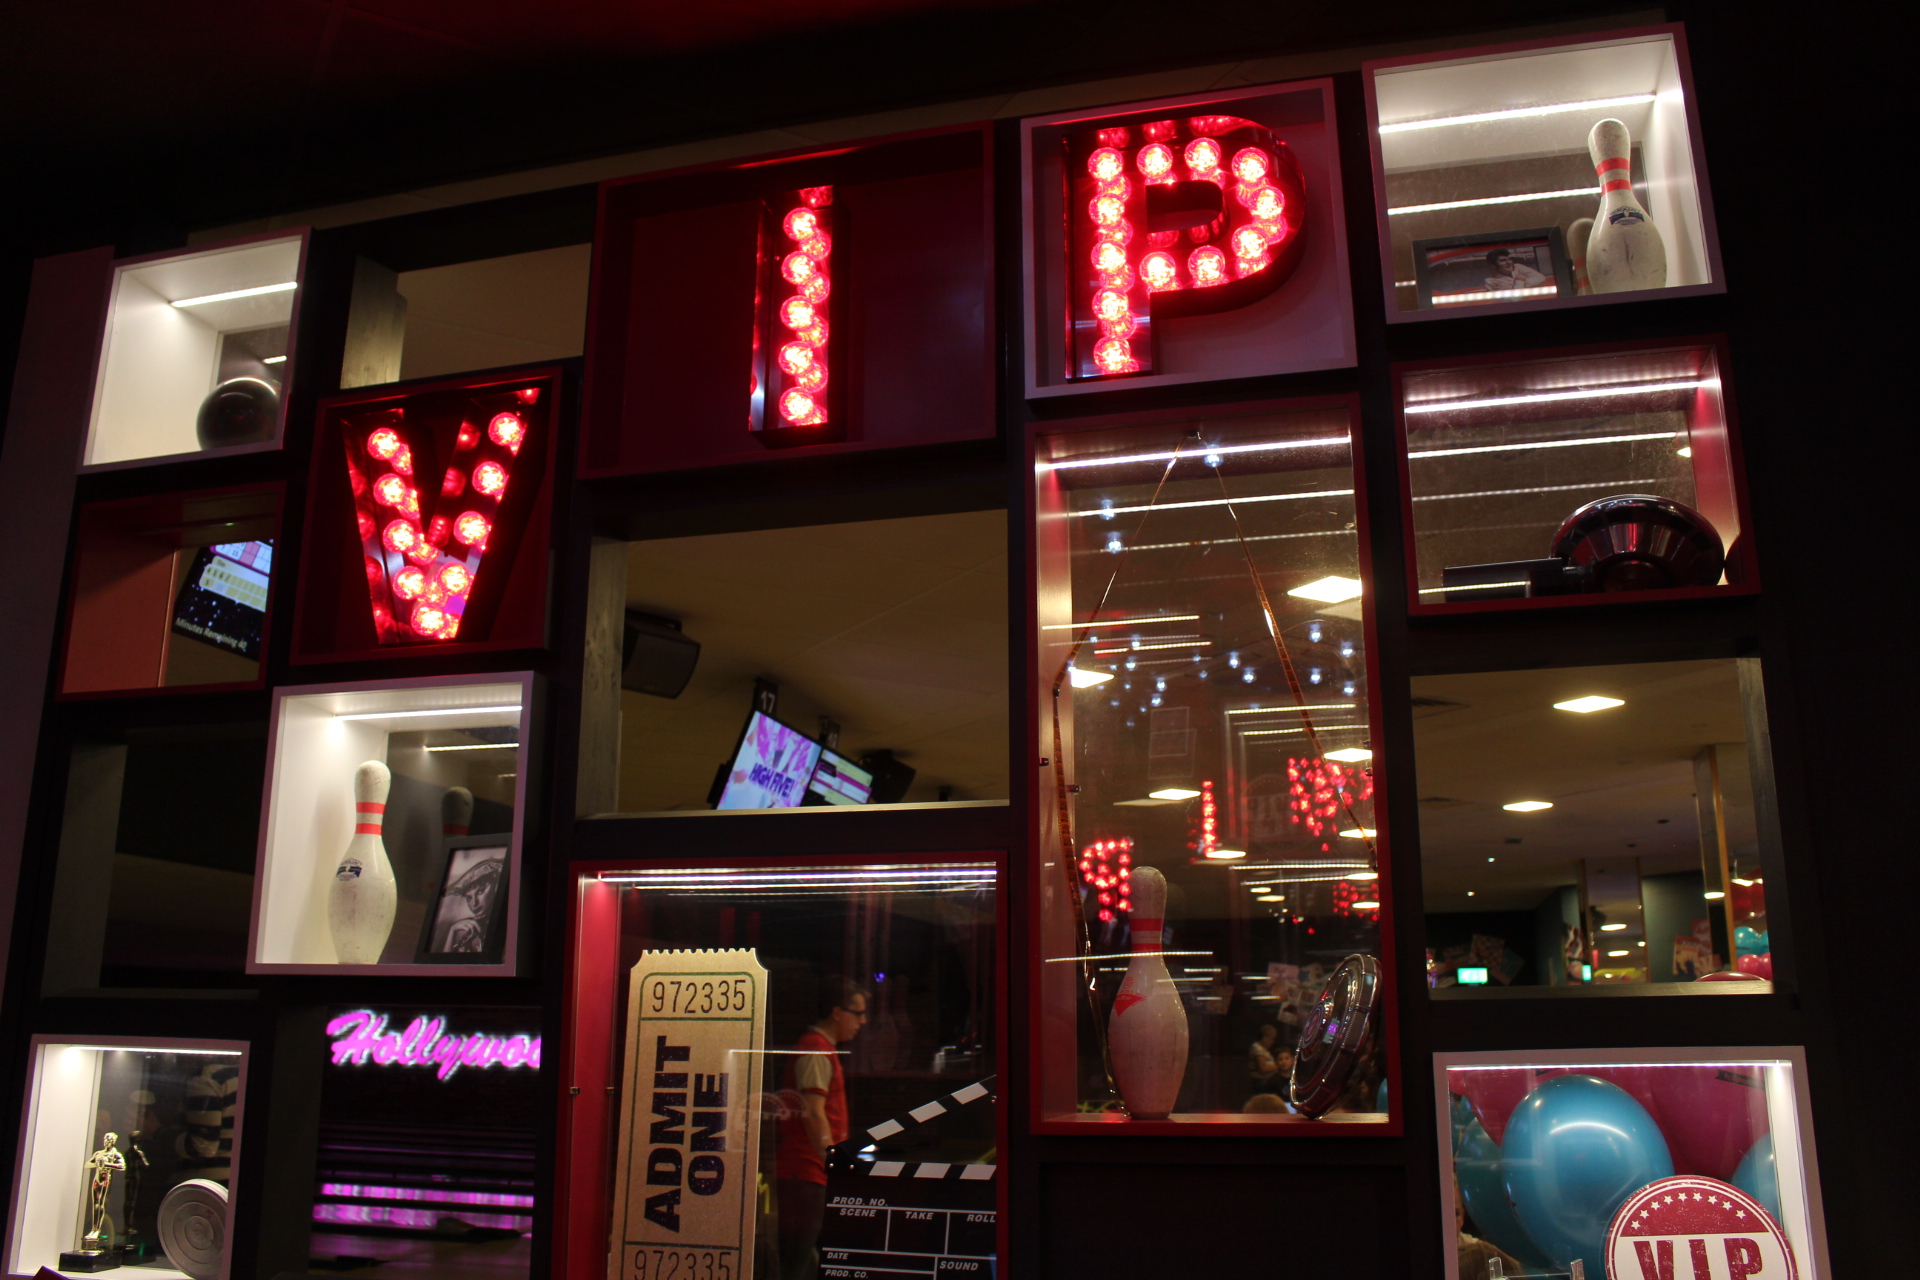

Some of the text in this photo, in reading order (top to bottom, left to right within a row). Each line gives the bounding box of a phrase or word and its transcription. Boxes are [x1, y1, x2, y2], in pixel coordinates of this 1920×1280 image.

[761, 691, 775, 713] 17
[750, 763, 795, 798] HIGH FIVE!
[652, 980, 746, 1014] 972335
[644, 1036, 690, 1232] ADMIT
[688, 1073, 729, 1196] ONE
[832, 1196, 888, 1207] PROD. NO.
[839, 1208, 877, 1217] SCENE
[905, 1211, 934, 1220] TAKE
[966, 1214, 996, 1223] ROLL
[826, 1252, 849, 1260] DATE
[1632, 1237, 1763, 1280] VIP
[633, 1249, 733, 1280] 972335
[939, 1261, 979, 1271] SOUND
[825, 1269, 868, 1279] PROD. CO.
